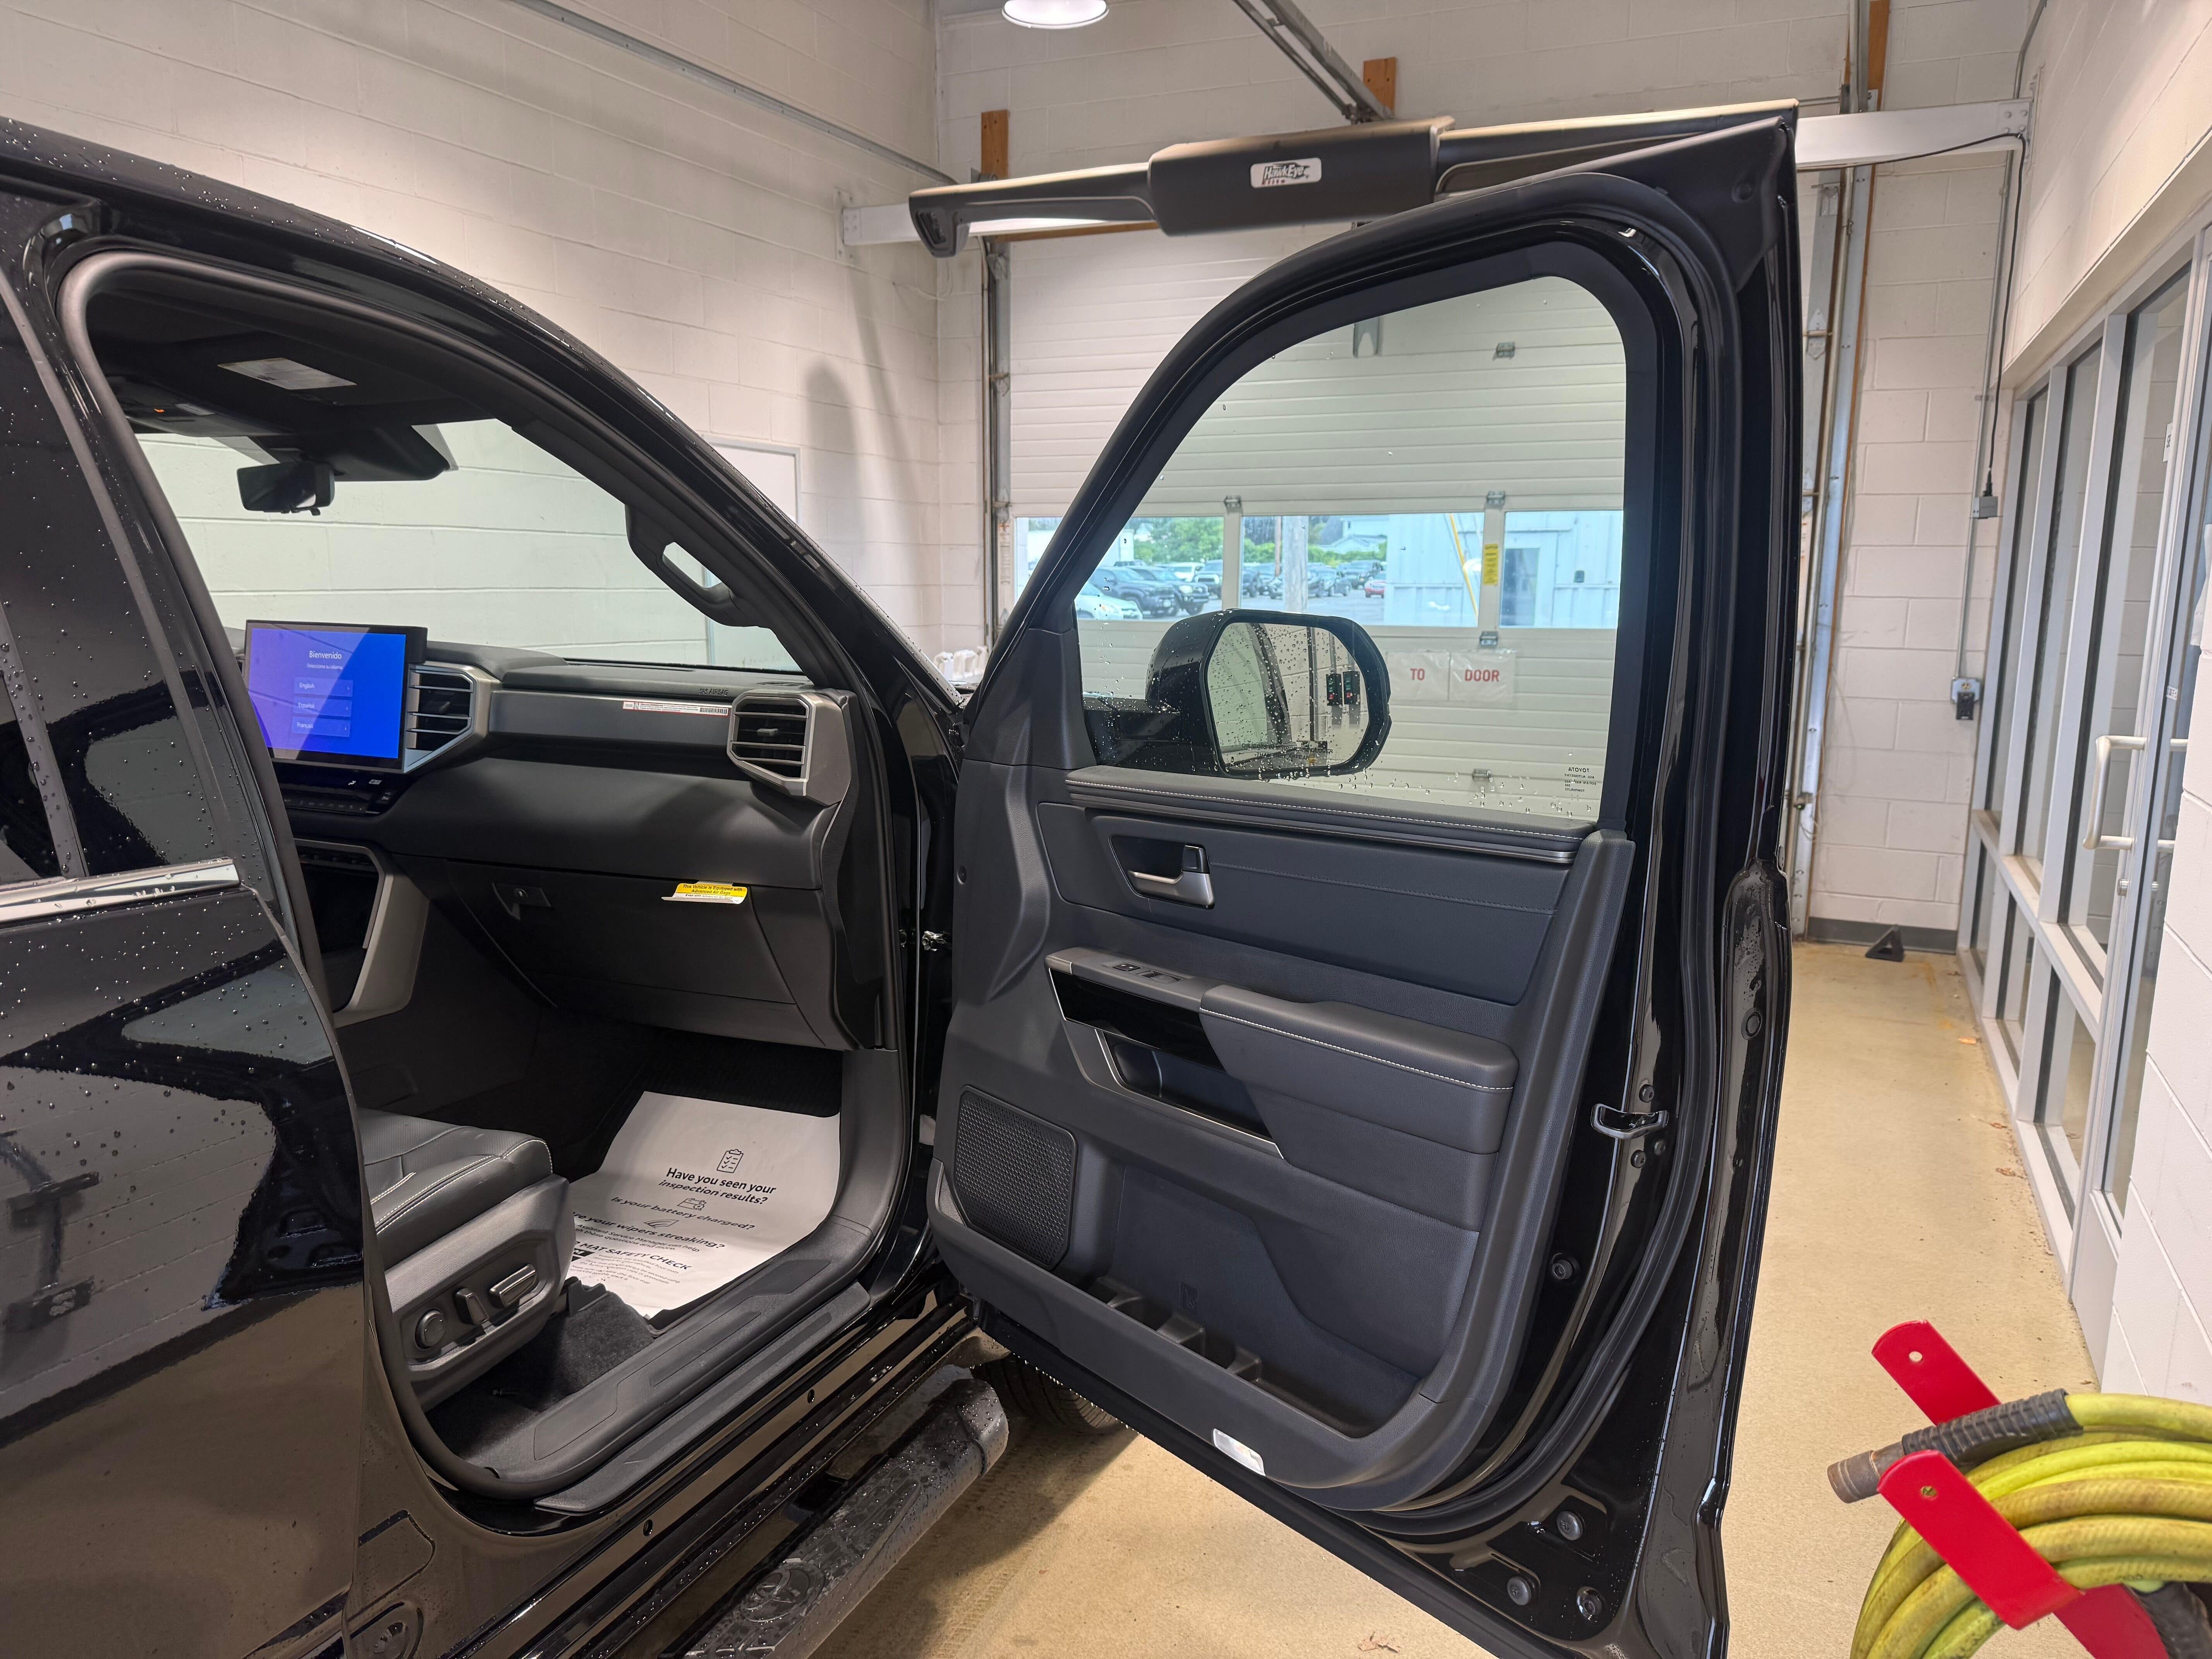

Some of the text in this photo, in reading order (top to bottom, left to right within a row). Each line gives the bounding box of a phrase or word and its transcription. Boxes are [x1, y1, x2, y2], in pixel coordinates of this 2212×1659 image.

[1264, 164, 1305, 179] HawkEye
[309, 651, 342, 659] Bienvenido
[1410, 668, 1500, 682] TO DOOR
[666, 1168, 776, 1194] Have you seen your
[659, 1180, 768, 1204] inspection results?
[651, 1206, 696, 1218] battery
[697, 1216, 755, 1230] charged?
[576, 1224, 608, 1234] Assistant
[636, 1238, 668, 1246] Manager
[585, 1218, 617, 1226] your
[617, 1224, 658, 1235] wipers
[657, 1233, 725, 1248] streaking?
[604, 1236, 639, 1245] questions
[605, 1249, 651, 1257] SAFETY
[649, 1255, 692, 1270] CHECK
